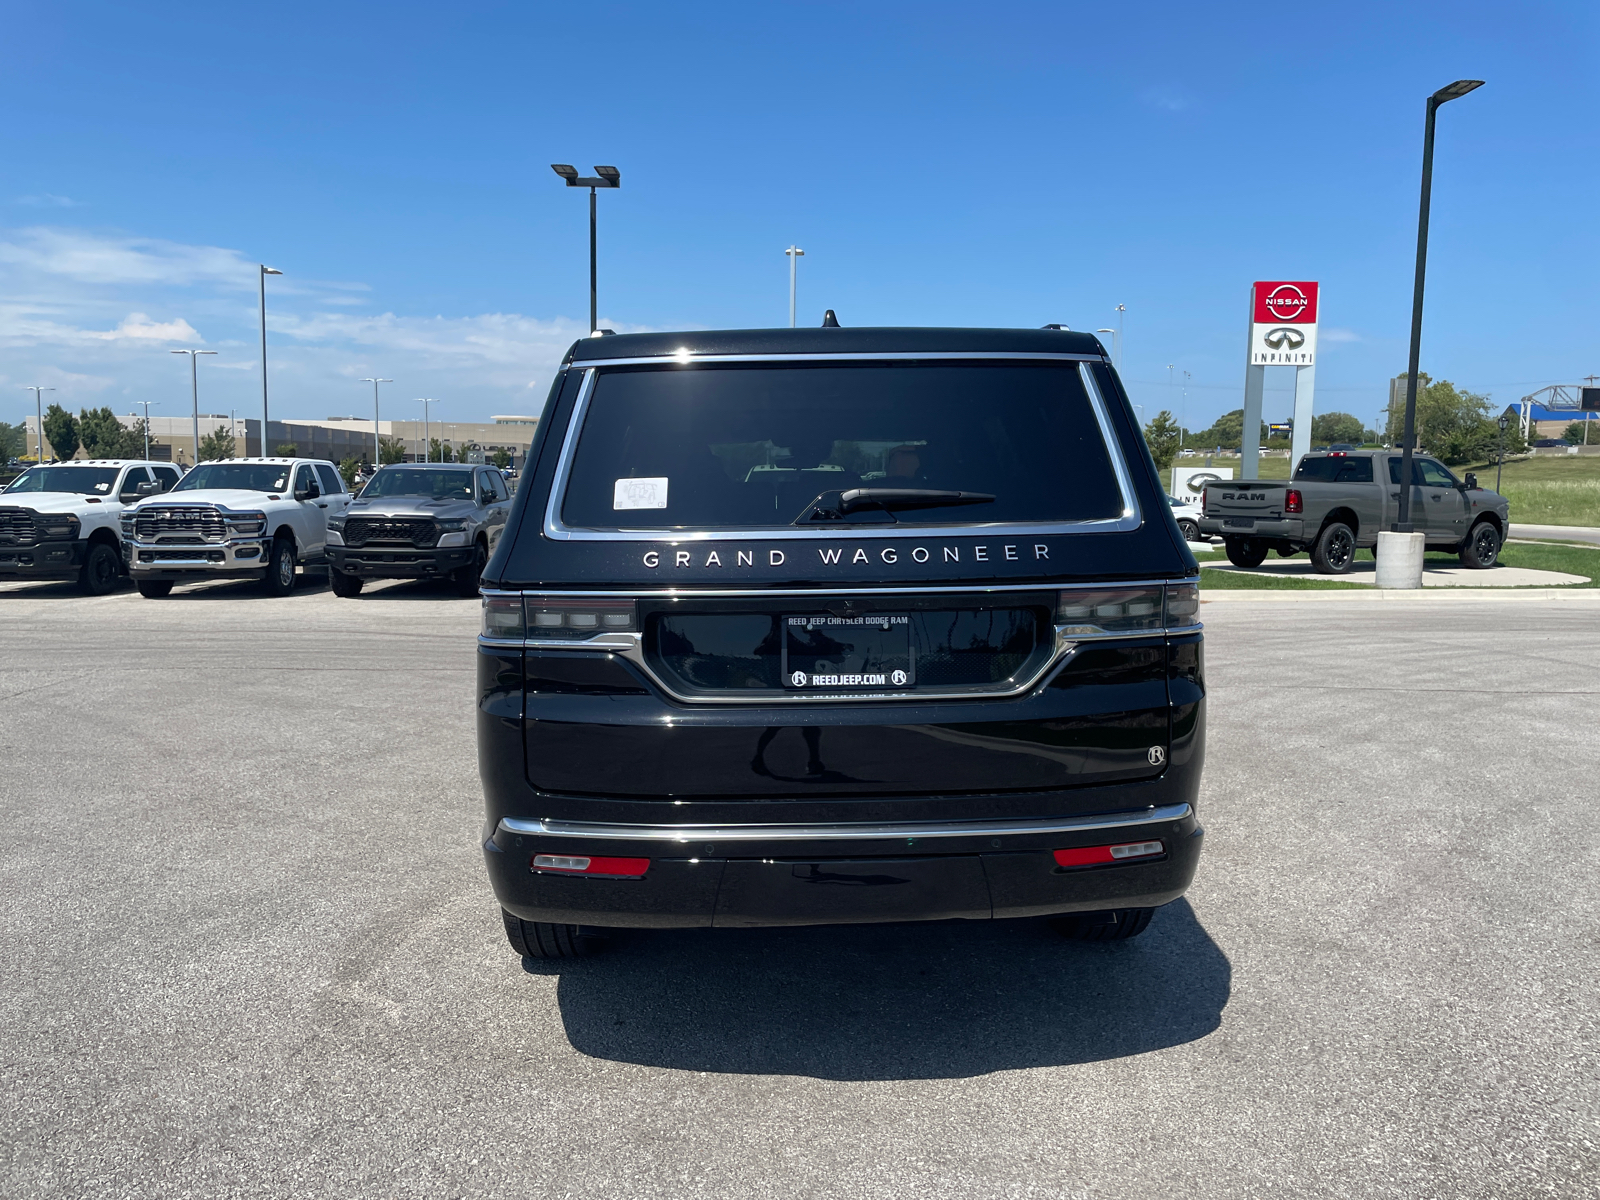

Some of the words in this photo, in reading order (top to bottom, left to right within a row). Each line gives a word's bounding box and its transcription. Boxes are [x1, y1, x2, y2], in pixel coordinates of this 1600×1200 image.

[1254, 353, 1312, 363] INFINITI
[1222, 493, 1266, 501] RAM
[643, 549, 786, 569] GRAND
[818, 544, 1050, 565] WAGONEER
[788, 617, 807, 626] REED
[809, 617, 826, 625] JEEP
[827, 616, 864, 625] CHRYSLER
[865, 616, 889, 625] DODGE
[891, 616, 908, 624] RAM
[812, 674, 886, 686] REEDJEEP.COM
